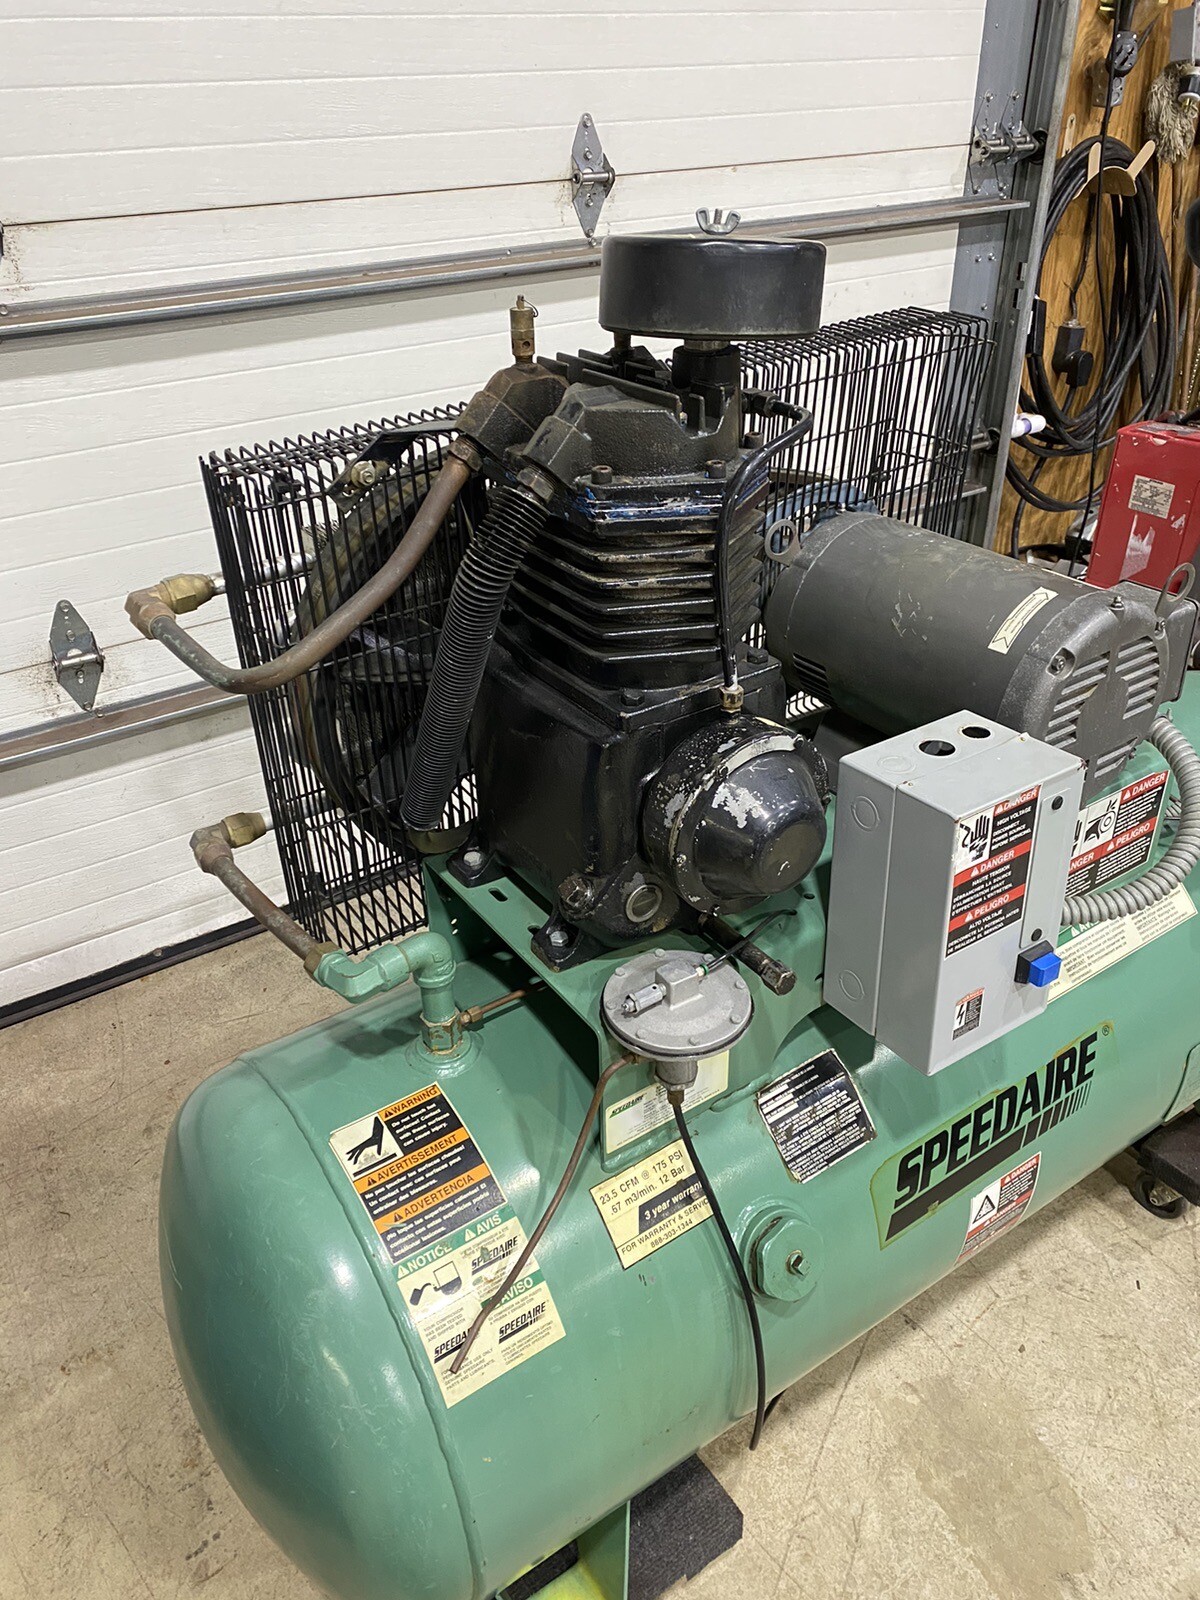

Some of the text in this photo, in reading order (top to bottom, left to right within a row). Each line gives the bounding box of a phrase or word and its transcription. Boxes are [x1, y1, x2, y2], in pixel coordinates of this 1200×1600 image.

[1131, 772, 1166, 795] DANGER
[1115, 822, 1150, 846] PELIGRO
[980, 849, 1014, 873] DANGER
[1069, 851, 1094, 870] NGER
[974, 892, 1009, 918] PELIGRO
[390, 1087, 438, 1114] WARNING
[391, 1102, 436, 1128] Do not touch hot
[398, 1111, 450, 1140] with these surfaces
[894, 1031, 1098, 1209] SPEEDAIRE
[375, 1133, 459, 1181] AVERTISSEMENT
[598, 1149, 683, 1205] 23.5 CFM @ 175 PSI
[608, 1162, 686, 1215] .67 m3/min. 12 Bar
[402, 1173, 474, 1216] ADVERTENCIA
[643, 1209, 651, 1220] 3
[650, 1198, 672, 1218] year
[670, 1179, 702, 1204] warran
[474, 1213, 502, 1235] AVIS
[620, 1241, 637, 1255] FOR
[637, 1216, 677, 1245] WARRANTY
[676, 1212, 683, 1221] &
[683, 1196, 708, 1216] SERVIC
[650, 1217, 692, 1248] 888-303-1344
[406, 1240, 452, 1272] NOTICE
[468, 1235, 520, 1270] SPEDAIRE
[499, 1275, 534, 1303] AVISO
[496, 1300, 548, 1338] SPEEDAIRE
[432, 1327, 473, 1357] SPEEDA
